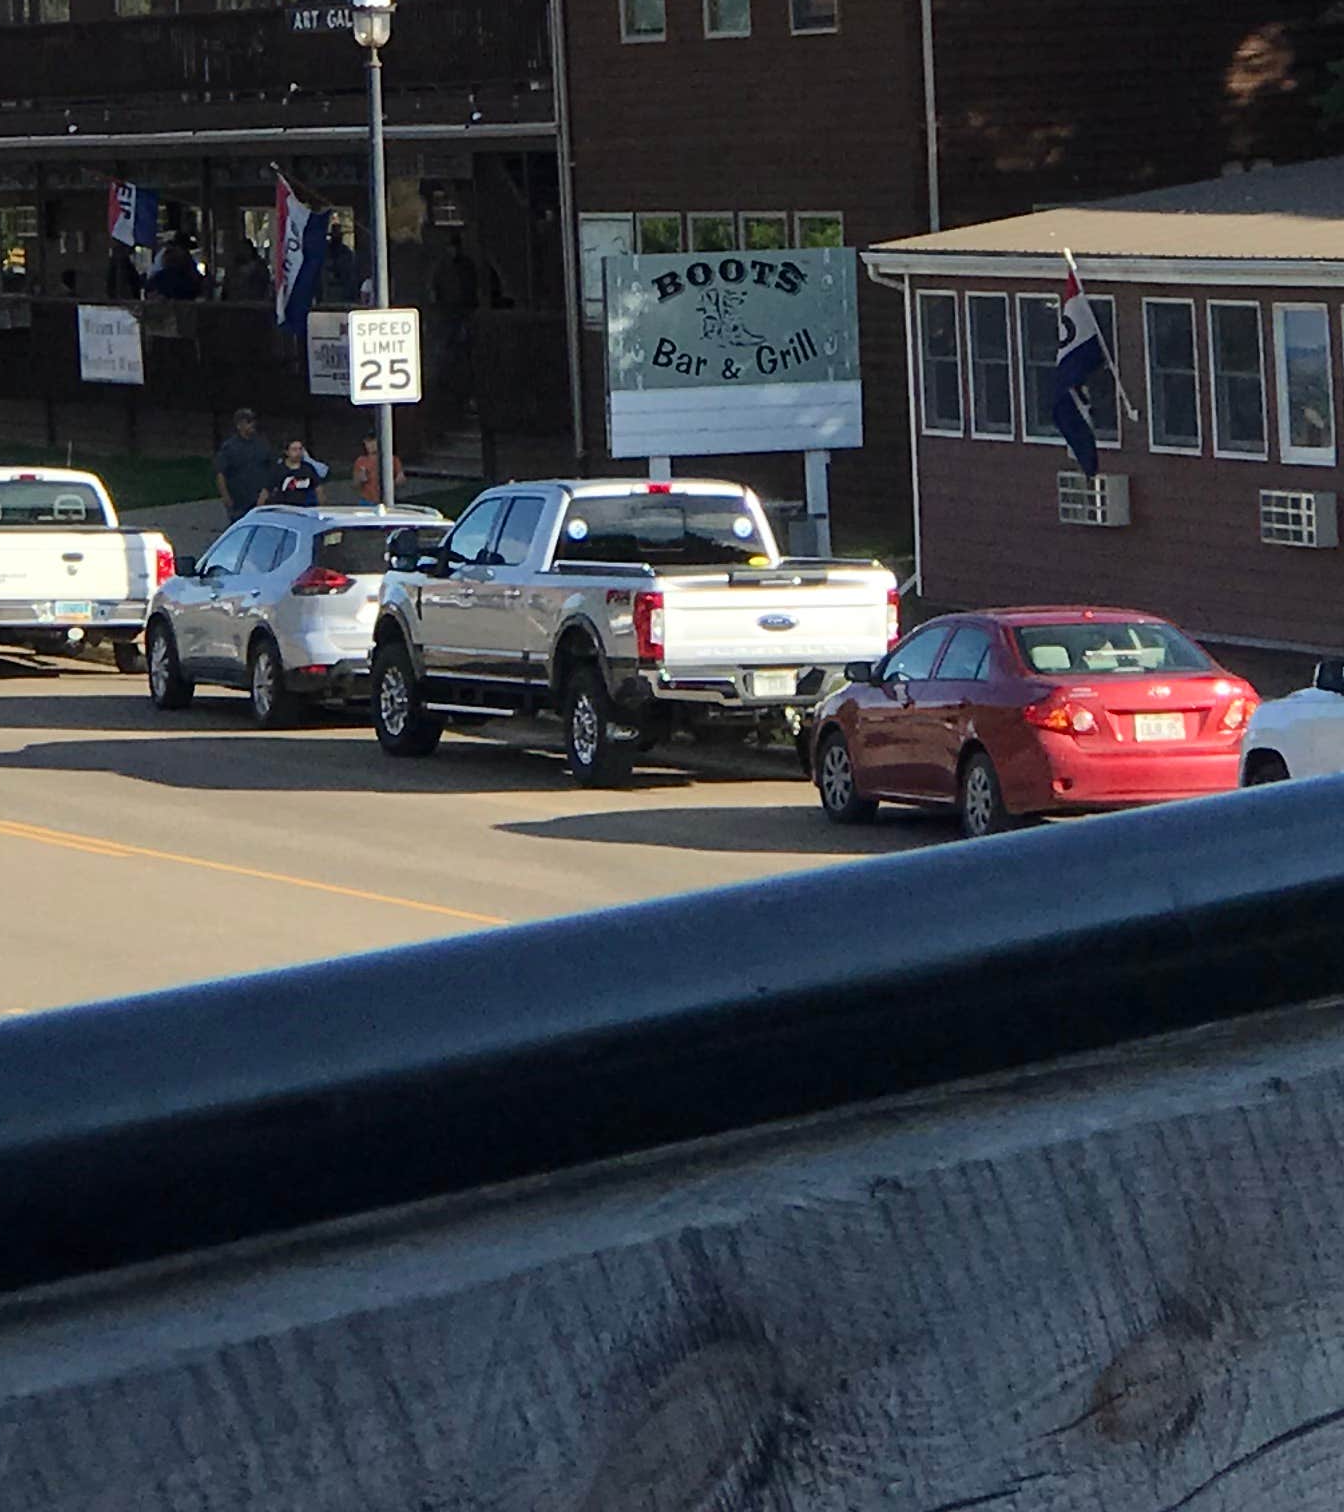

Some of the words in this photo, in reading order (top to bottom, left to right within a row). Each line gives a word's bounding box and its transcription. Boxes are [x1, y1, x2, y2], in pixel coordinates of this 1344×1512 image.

[293, 9, 320, 30] ART
[326, 8, 354, 29] GAL
[651, 258, 808, 303] BOOTS
[356, 321, 412, 337] SPEED
[363, 339, 406, 355] LIMIT
[652, 337, 708, 376] Bar
[721, 357, 743, 380] &
[756, 328, 818, 375] Grill
[360, 358, 411, 391] 25
